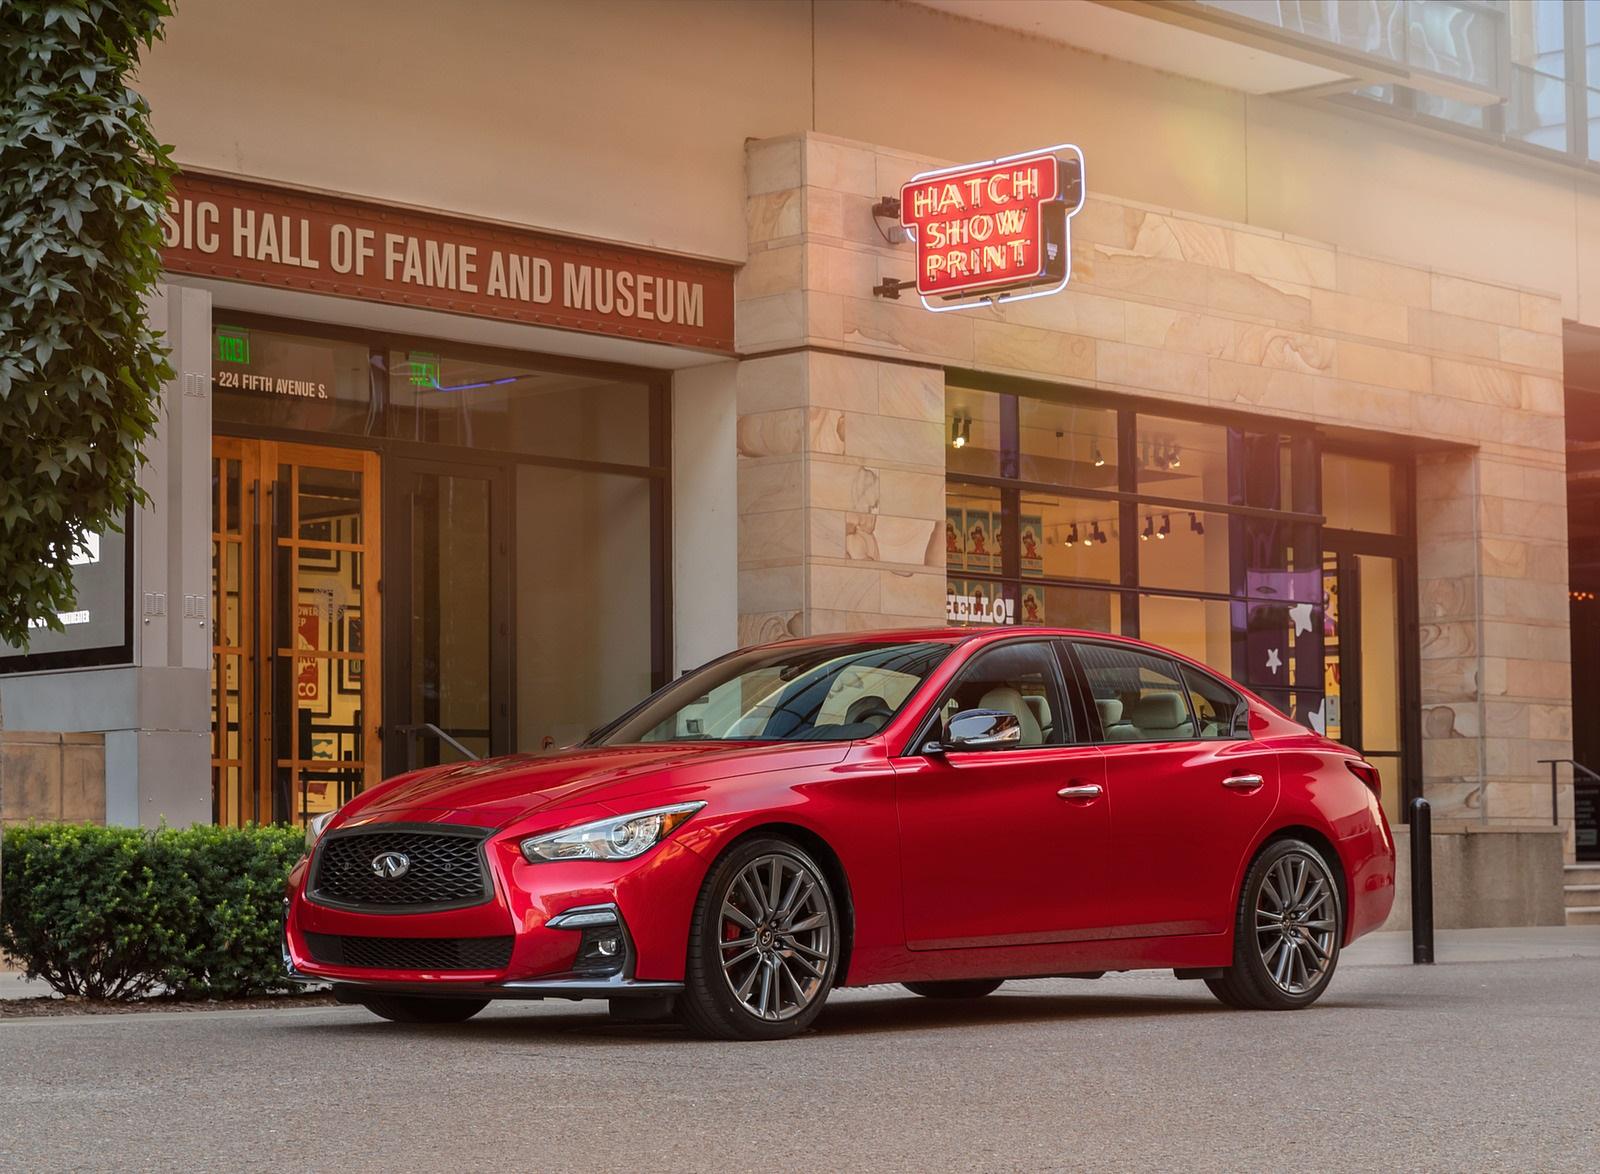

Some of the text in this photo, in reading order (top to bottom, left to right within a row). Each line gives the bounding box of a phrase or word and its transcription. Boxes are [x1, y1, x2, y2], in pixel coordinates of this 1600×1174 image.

[914, 168, 1038, 218] HATCH
[926, 208, 1027, 248] SHOW
[233, 207, 319, 269] HALL
[330, 224, 374, 276] OF
[385, 232, 478, 293] FAME
[487, 251, 552, 304] AND
[563, 262, 704, 327] MUSEUM
[926, 239, 1031, 282] PRINT
[219, 371, 328, 399] 224 FIFTH AVENUE S.
